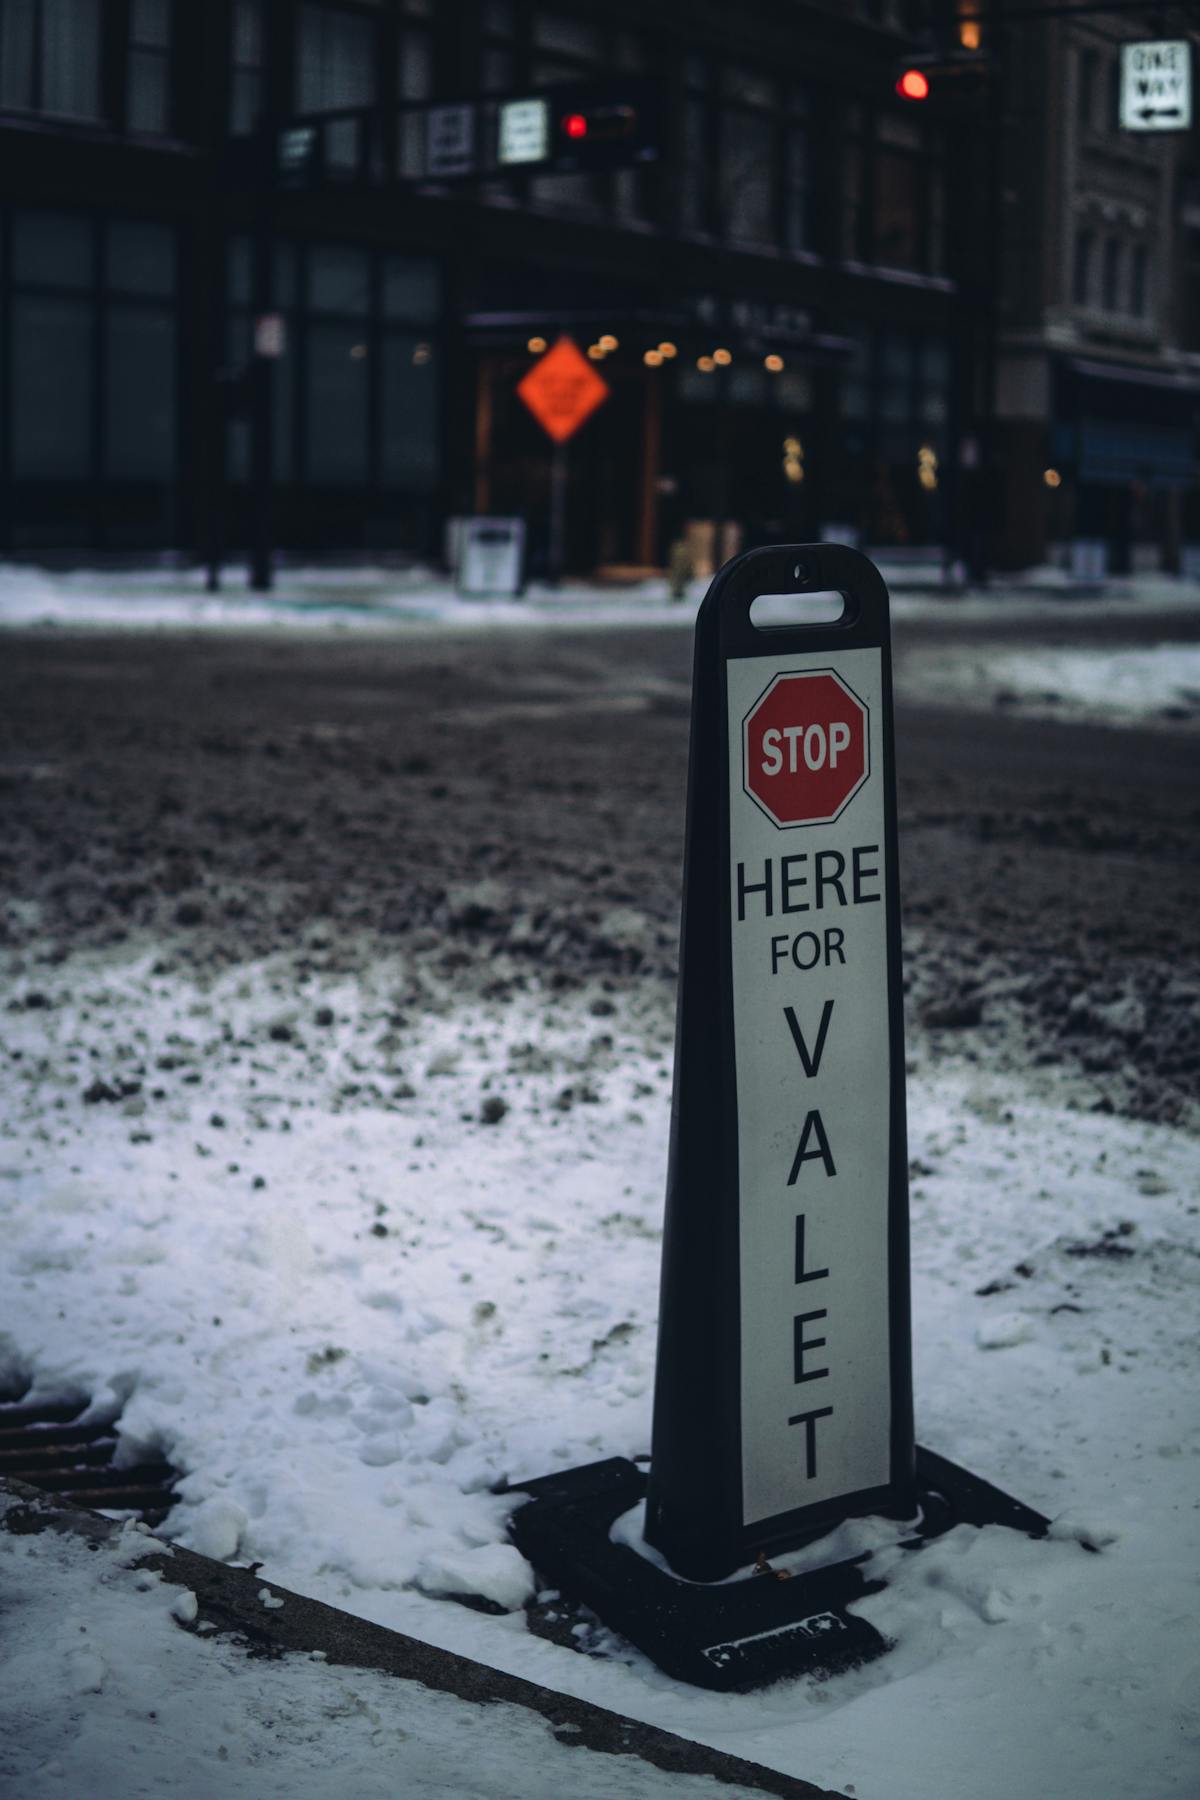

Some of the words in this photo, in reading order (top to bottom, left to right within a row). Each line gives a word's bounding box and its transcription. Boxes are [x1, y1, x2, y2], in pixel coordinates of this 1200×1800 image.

[761, 722, 850, 776] STOP
[737, 845, 881, 921] HERE
[771, 928, 846, 974] FOR
[783, 1000, 837, 1479] VALET
